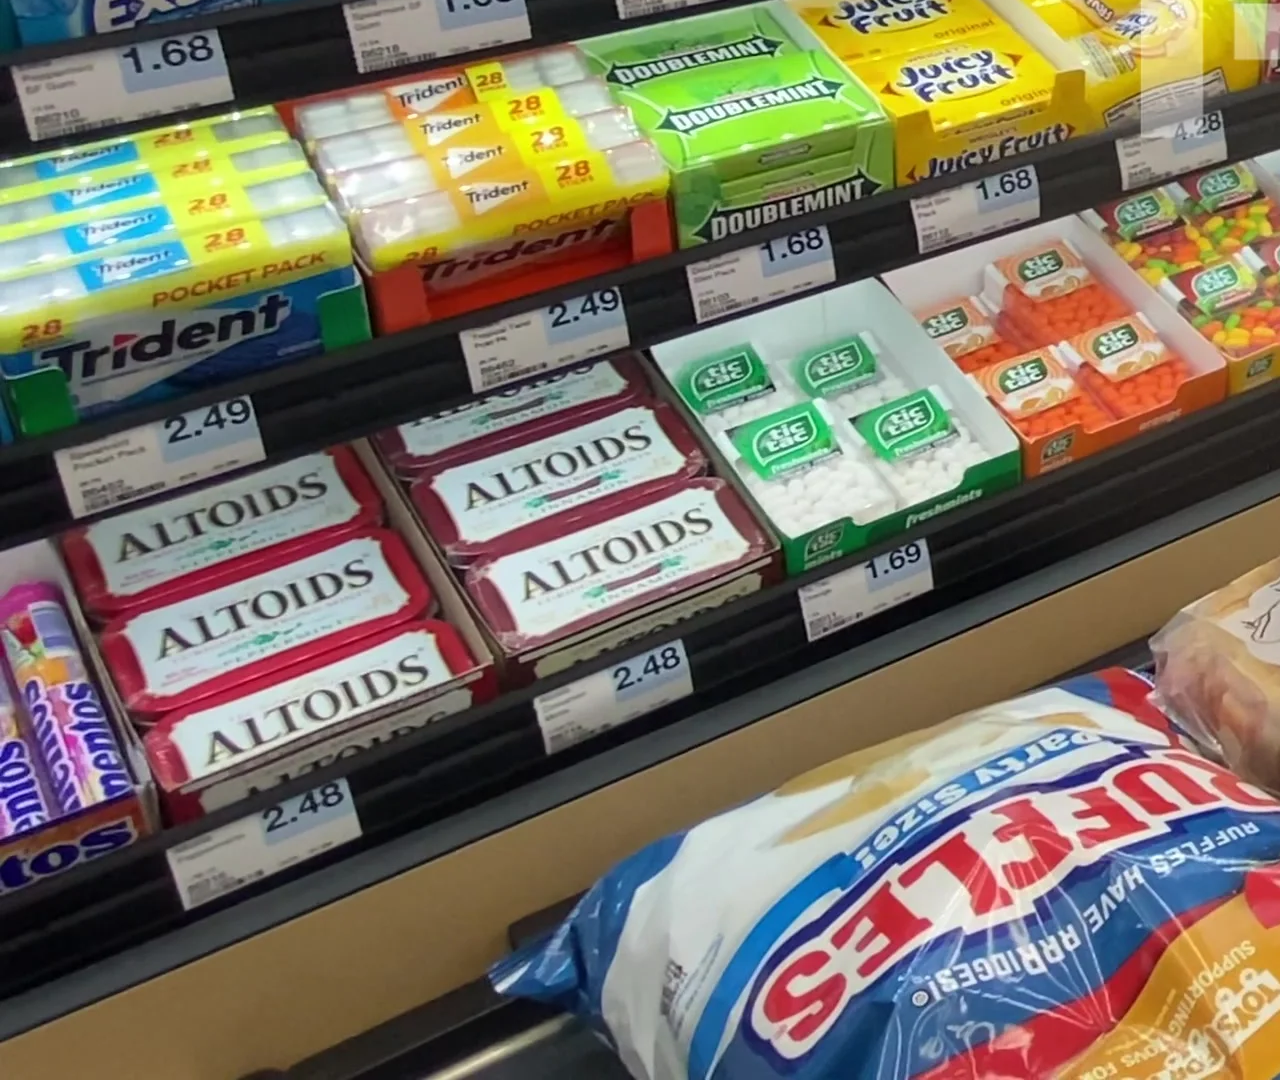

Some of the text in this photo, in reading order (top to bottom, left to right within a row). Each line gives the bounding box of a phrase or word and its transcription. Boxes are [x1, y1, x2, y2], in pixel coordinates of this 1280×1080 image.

[933, 18, 994, 40] original
[123, 35, 214, 74] 1.68
[419, 112, 481, 136] Trident
[510, 95, 542, 117] 28
[672, 79, 830, 134] DOUBLEMINT
[1174, 112, 1221, 139] 4.28
[976, 171, 1033, 200] 1.68
[711, 179, 865, 241] DOUBLEMINT
[204, 229, 246, 249] 28
[760, 231, 823, 263] 1.68
[96, 249, 173, 275] Trident
[152, 251, 327, 308] POCKET PACK
[22, 318, 63, 342] 28
[548, 289, 618, 328] 2.49
[43, 293, 290, 380] Trident
[164, 399, 250, 444] 2.49
[765, 430, 811, 452] tac
[768, 420, 804, 438] tic
[463, 425, 652, 512] ALTOIDS
[114, 471, 328, 563] ALTOIDS
[906, 488, 982, 527] freshmints
[520, 505, 713, 601] ALTOIDS
[864, 544, 922, 579] 1.69
[612, 647, 681, 691] 2.48
[204, 653, 429, 765] ALTOIDS
[262, 784, 345, 833] 2.48
[855, 730, 1102, 870] Party Size!
[1149, 822, 1260, 872] RUFFLES
[762, 758, 1275, 1043] RUFFLES
[1083, 865, 1143, 933] HAVE
[1167, 940, 1256, 1037] SUPPORTING
